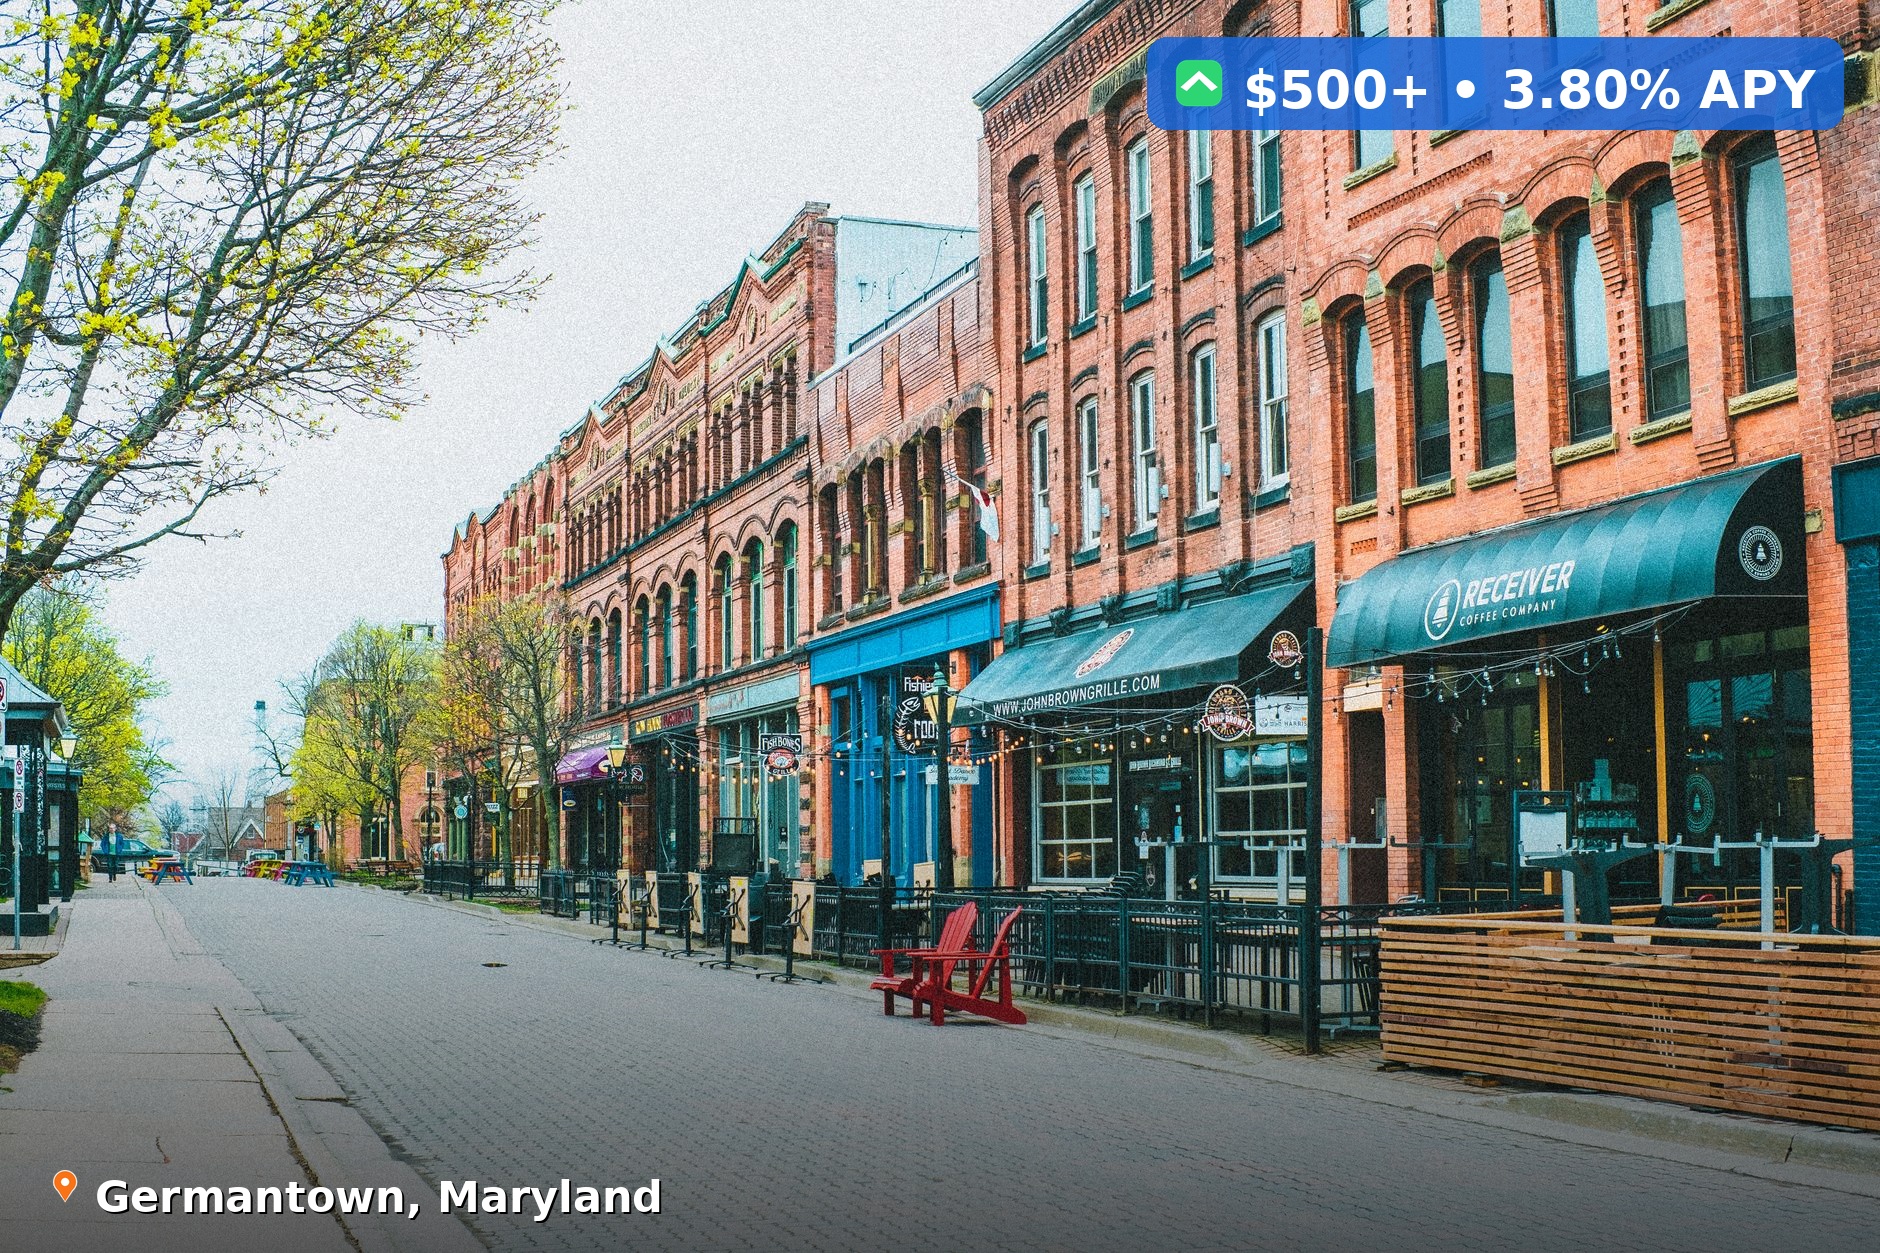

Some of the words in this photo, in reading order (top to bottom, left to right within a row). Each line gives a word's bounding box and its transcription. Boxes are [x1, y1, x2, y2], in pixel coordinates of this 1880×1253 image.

[1462, 560, 1576, 609] RECEIVER
[1460, 610, 1498, 626] COFFEE
[1502, 599, 1556, 618] COMPANY
[993, 674, 1160, 716] WWW.JOHNBROWNGRILLE.COM
[1225, 715, 1248, 728] BROWN
